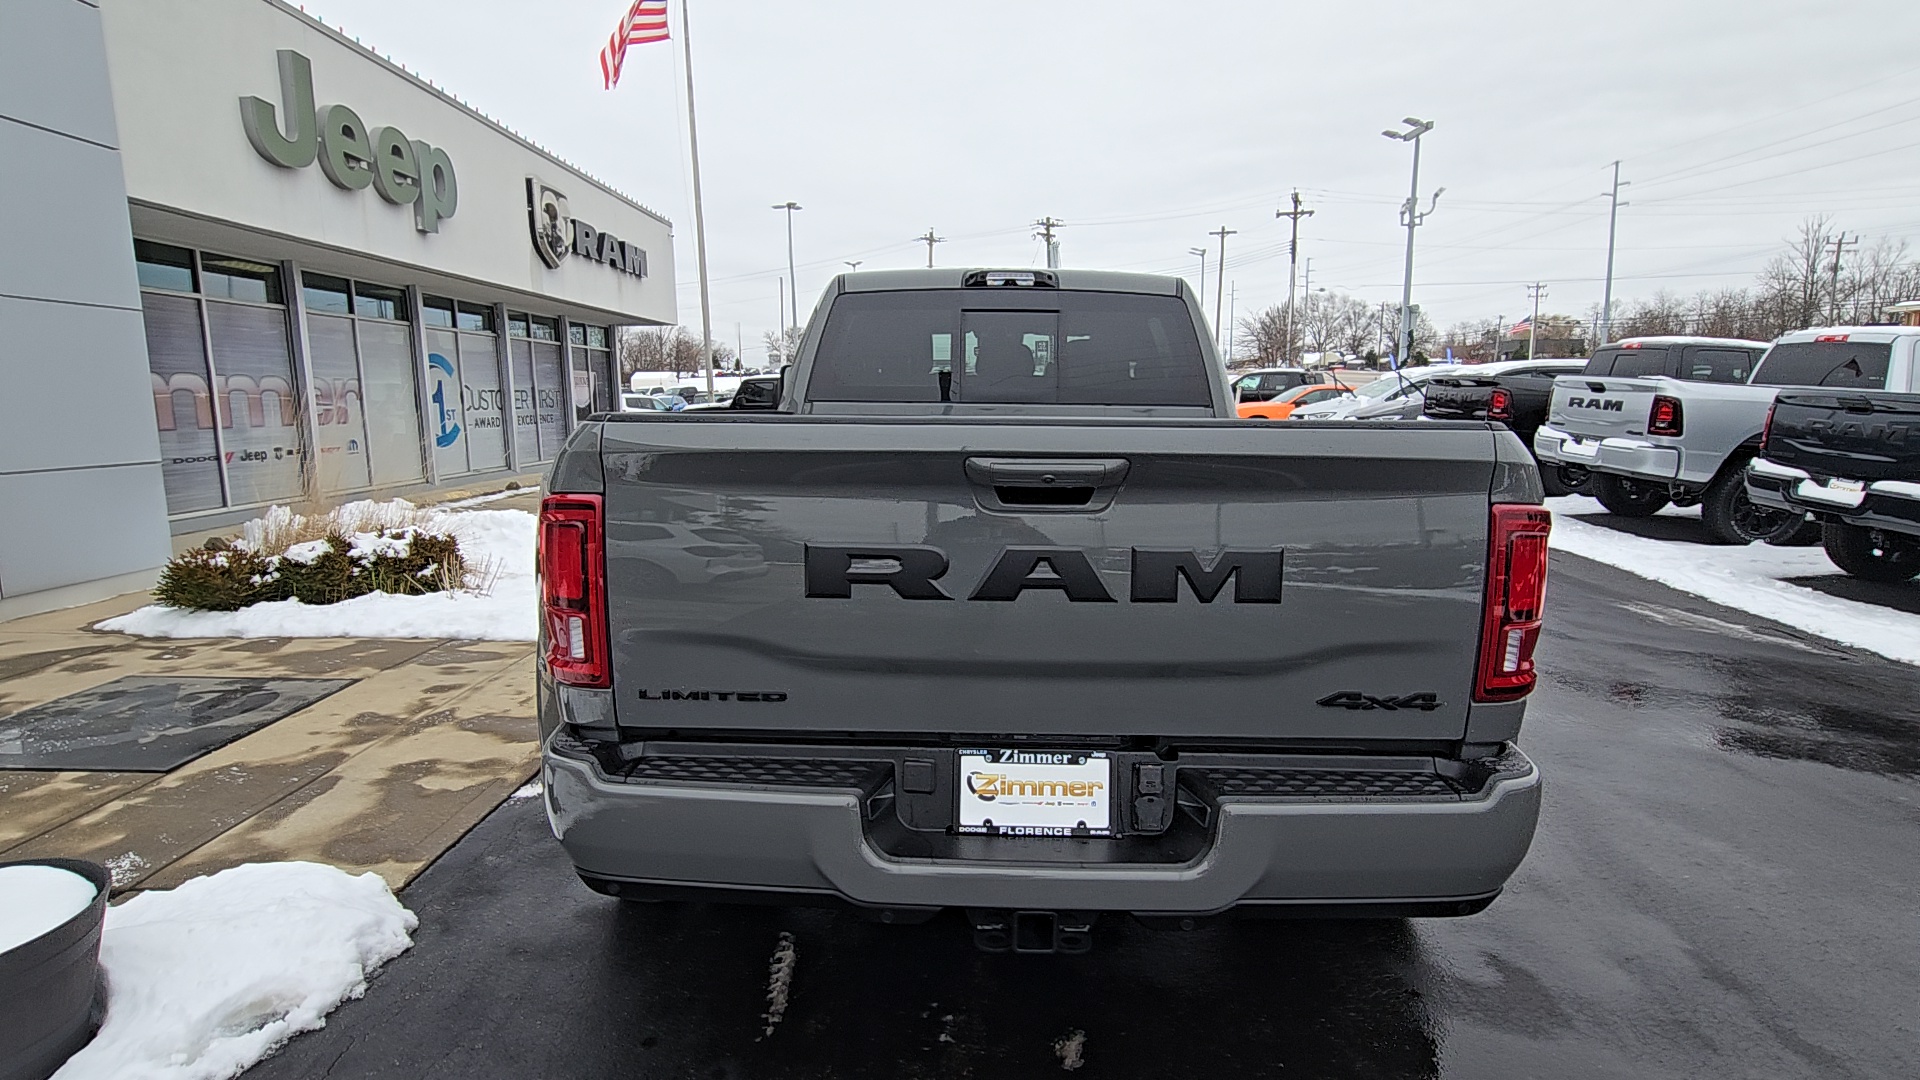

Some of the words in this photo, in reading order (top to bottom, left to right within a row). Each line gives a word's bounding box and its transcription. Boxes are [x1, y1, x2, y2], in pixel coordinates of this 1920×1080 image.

[239, 49, 458, 234] Jeep
[570, 218, 649, 279] RAM
[463, 384, 529, 412] CUSTOER
[1568, 396, 1624, 413] RAM
[474, 416, 501, 429] AWARD
[517, 413, 555, 426] EXCELENCE
[1806, 417, 1909, 445] RAM
[172, 453, 219, 466] DODG
[240, 449, 268, 463] Jeep
[804, 541, 1285, 604] RAM
[638, 688, 789, 702] LIMITED
[1315, 690, 1443, 711] 4x4
[1000, 749, 1072, 764] Zimmer
[975, 773, 1104, 798] Zimmer
[999, 826, 1073, 836] FLORENCE
